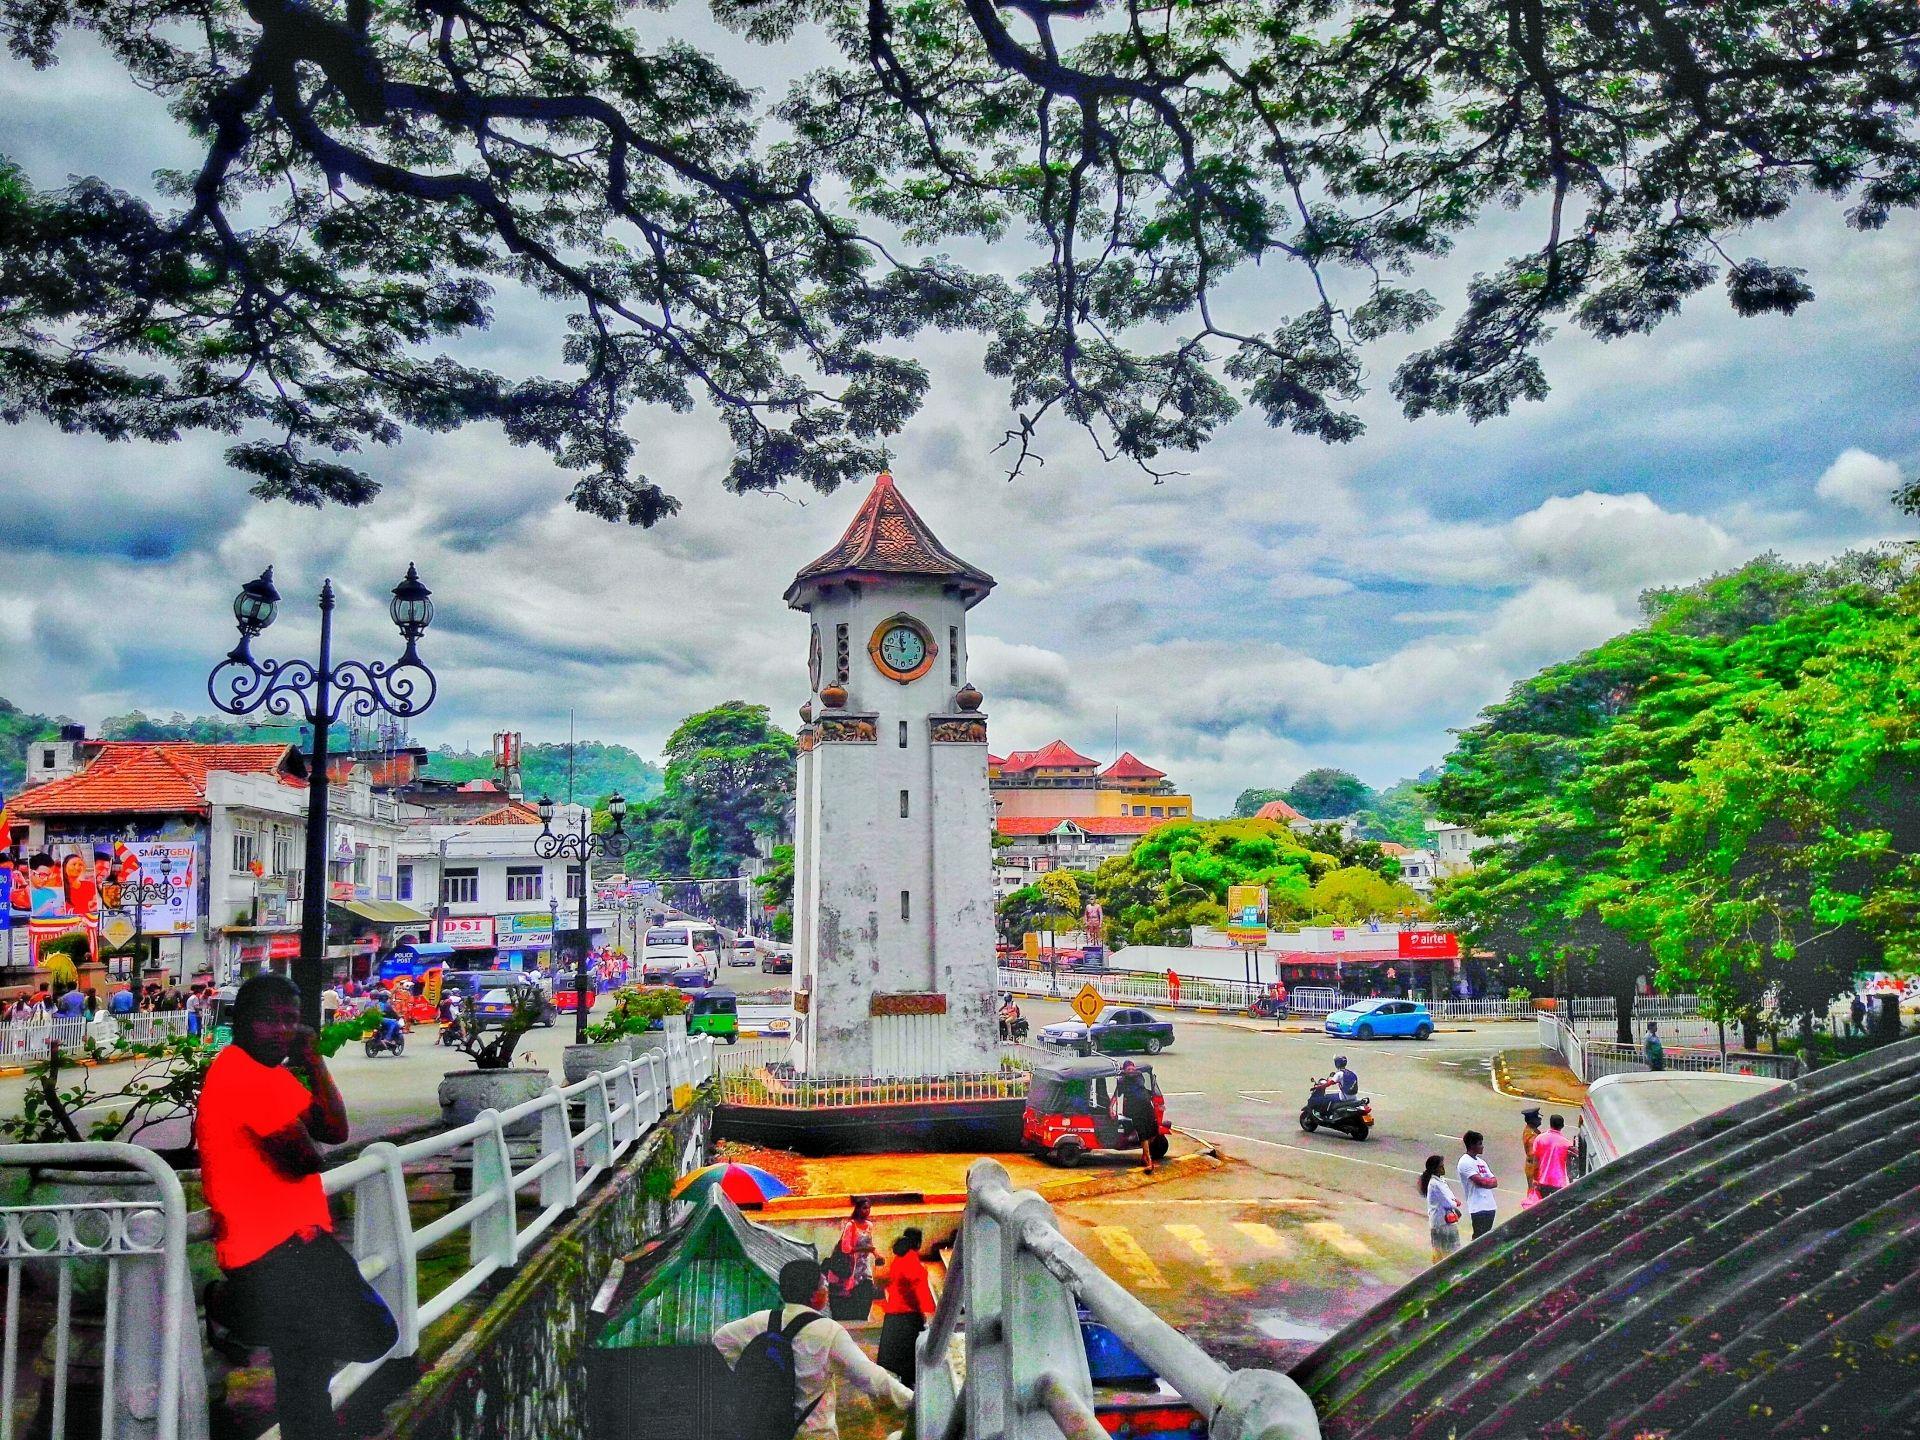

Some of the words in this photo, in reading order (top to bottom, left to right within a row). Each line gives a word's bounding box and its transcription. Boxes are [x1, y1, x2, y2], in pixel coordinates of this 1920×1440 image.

[138, 848, 190, 857] SMARTGEN
[444, 921, 481, 932] DSI
[1420, 933, 1447, 944] airtel
